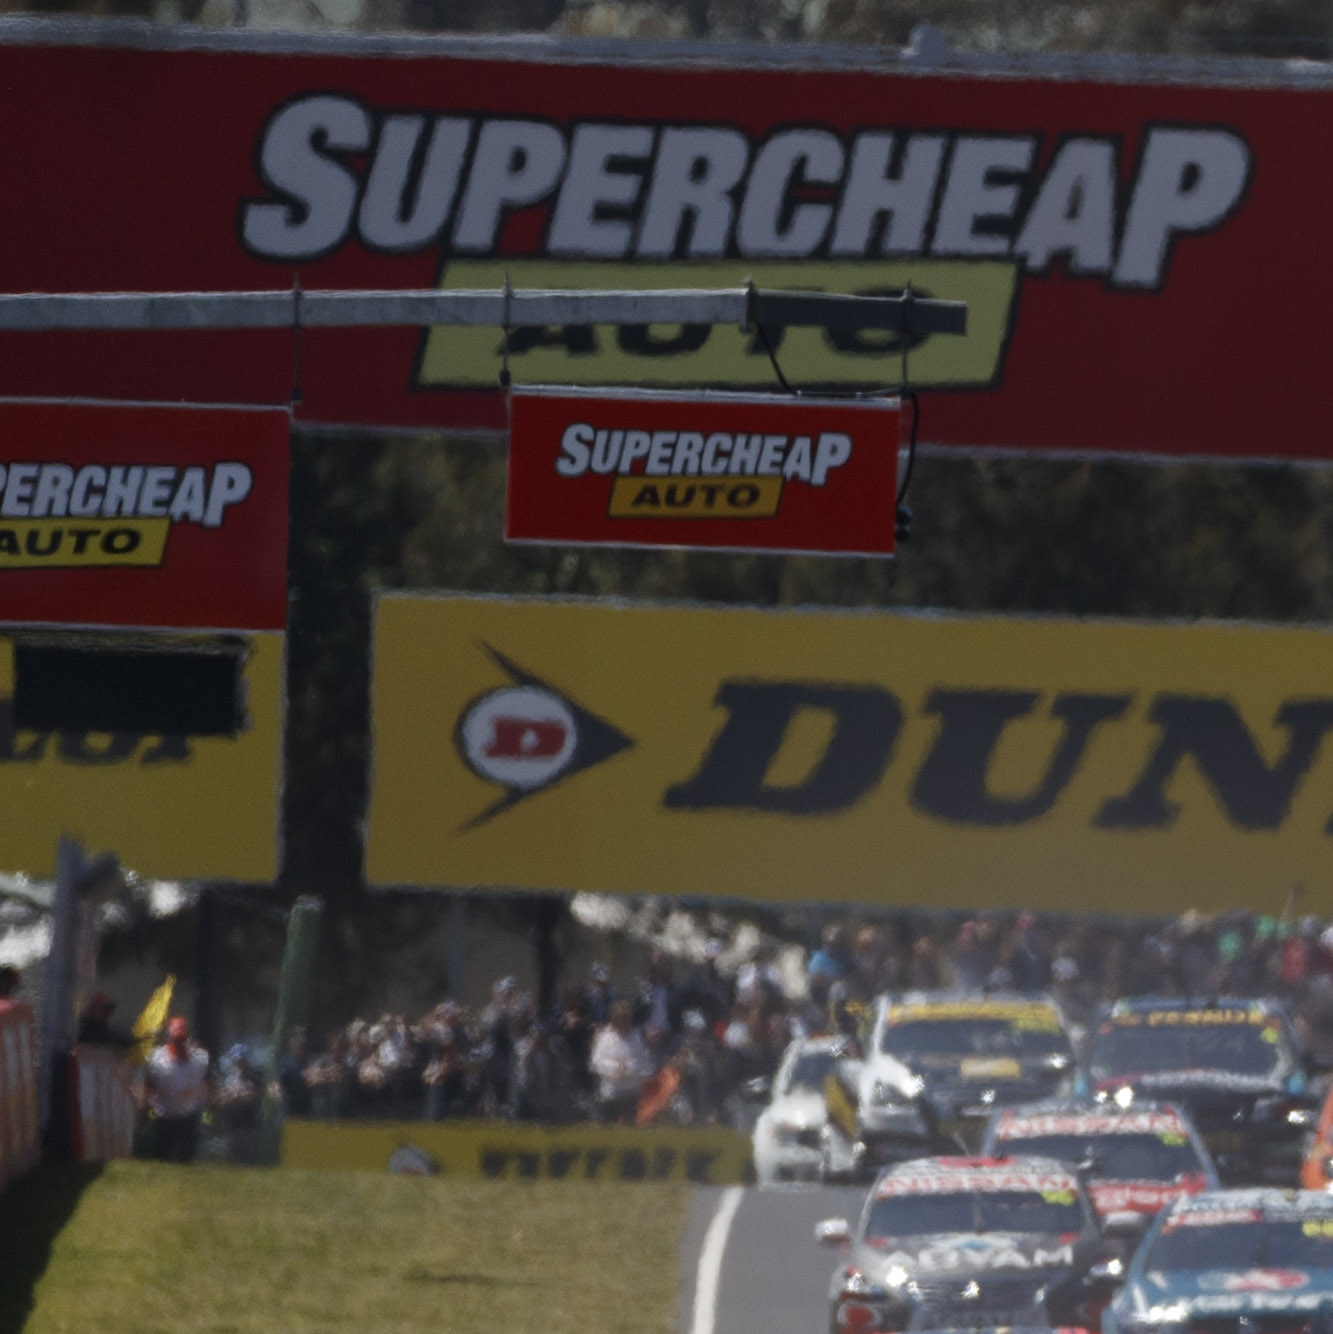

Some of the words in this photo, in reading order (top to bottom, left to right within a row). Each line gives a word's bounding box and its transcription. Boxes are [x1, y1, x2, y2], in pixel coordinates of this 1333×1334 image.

[243, 96, 1249, 288] SUPERCHEAP
[557, 423, 850, 485] SUPERCHEAP
[630, 482, 760, 511] AUTO
